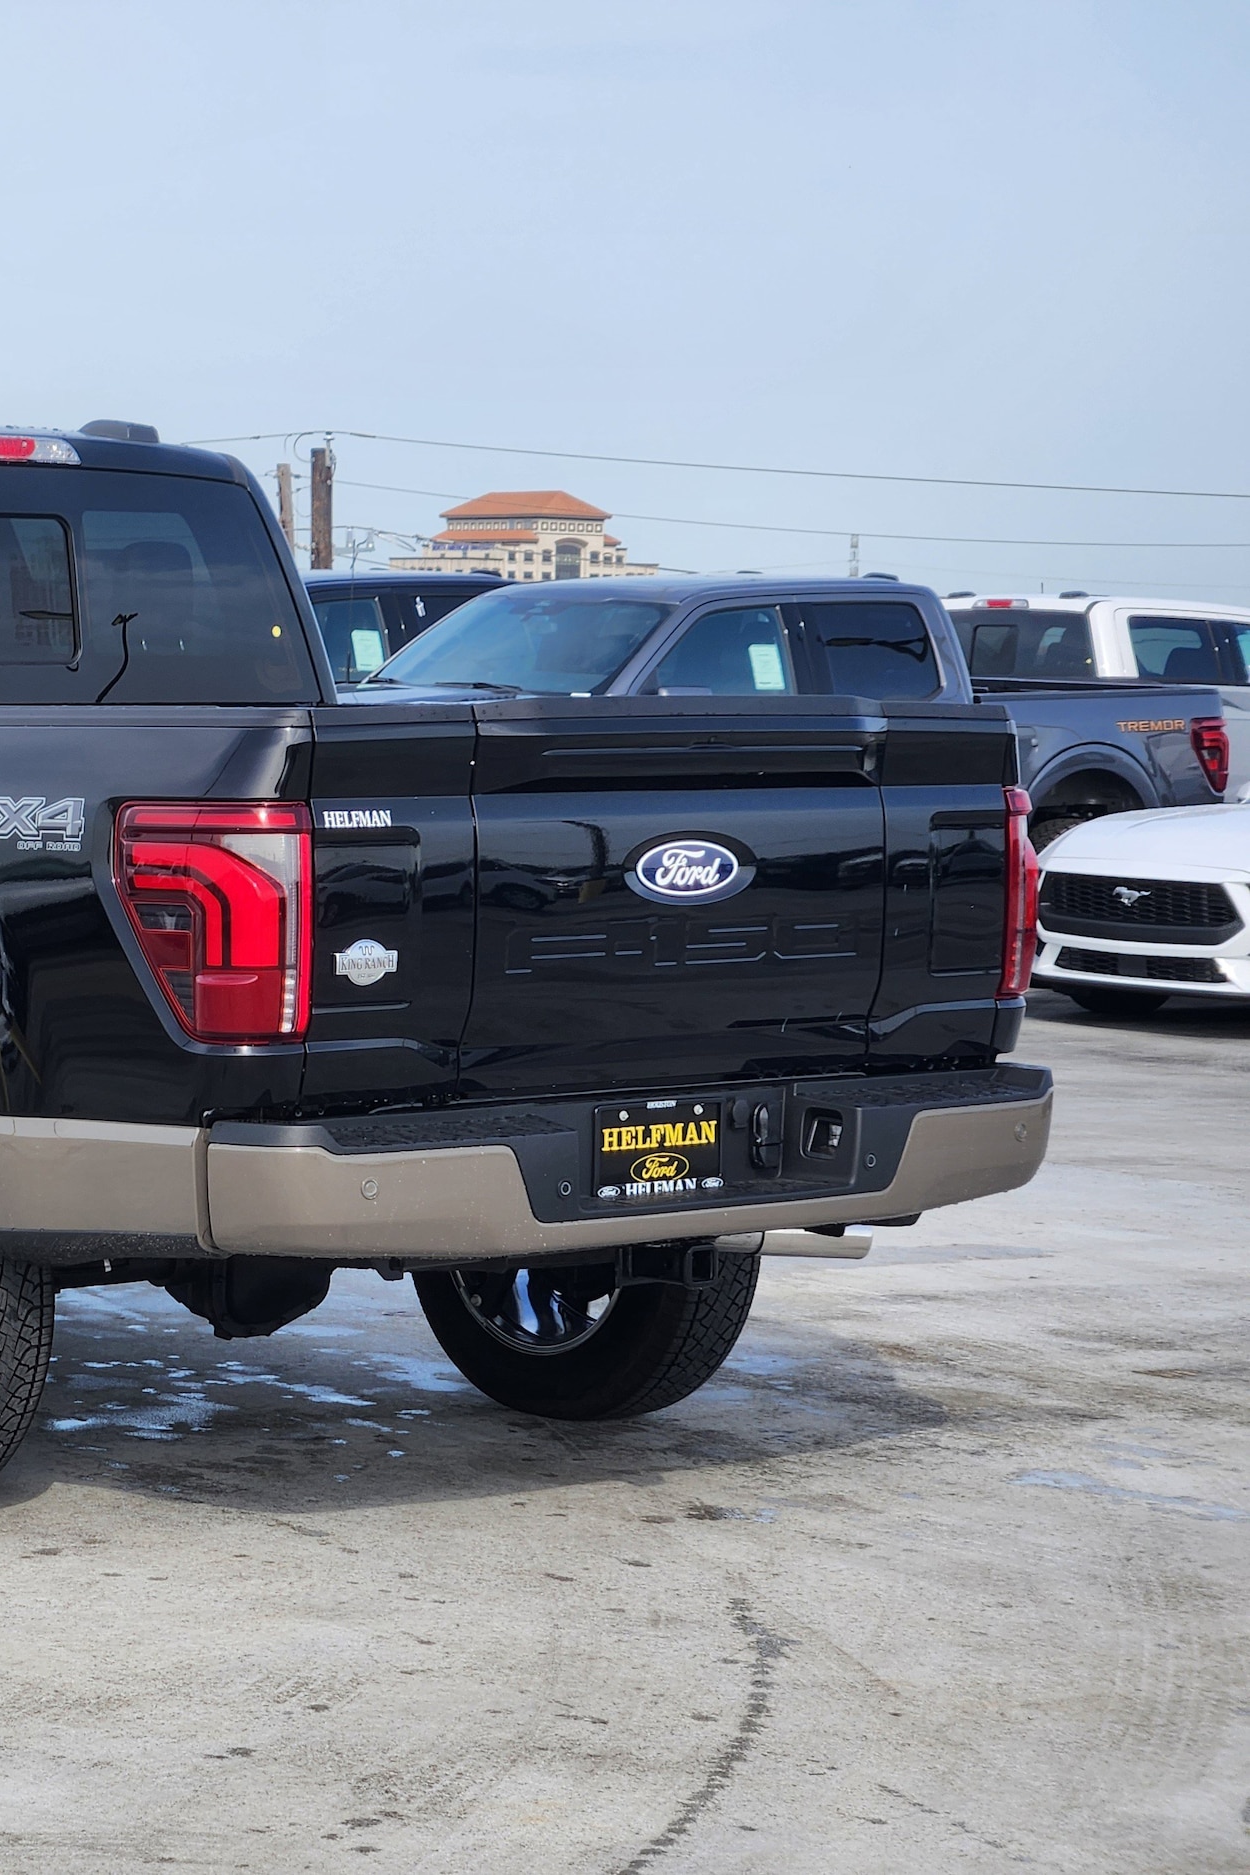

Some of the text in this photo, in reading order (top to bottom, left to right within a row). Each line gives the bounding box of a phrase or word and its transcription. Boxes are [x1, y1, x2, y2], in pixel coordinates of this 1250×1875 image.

[1116, 719, 1186, 733] TREMOR
[322, 809, 392, 829] HELFMAN
[16, 840, 82, 852] OFF ROAD
[654, 848, 722, 886] Ford
[340, 954, 395, 971] KING RANCH
[601, 1120, 718, 1152] HELFMAN
[641, 1156, 679, 1179] Ford
